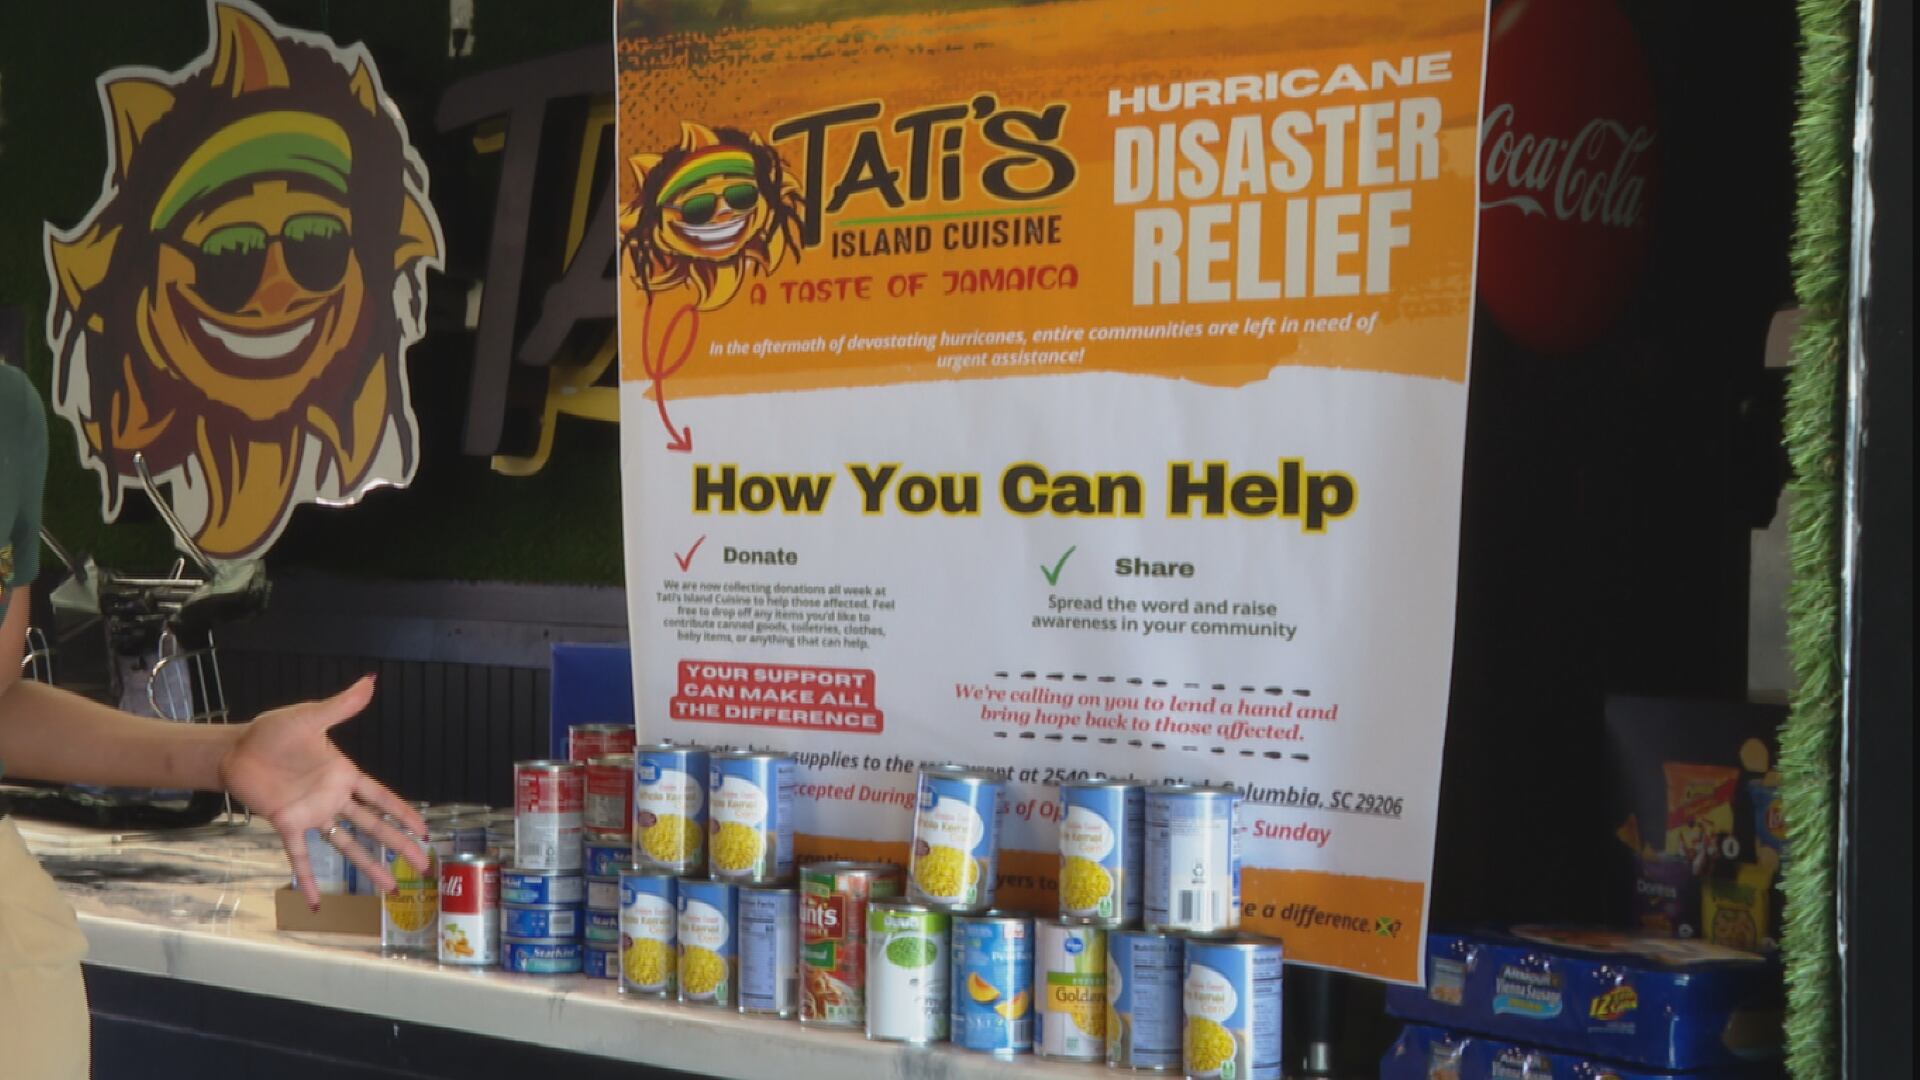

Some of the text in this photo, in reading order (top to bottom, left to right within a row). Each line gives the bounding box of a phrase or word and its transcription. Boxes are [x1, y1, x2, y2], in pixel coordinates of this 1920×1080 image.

[1108, 51, 1452, 117] HURRICANE
[1113, 97, 1442, 206] DISASTER
[831, 215, 1062, 259] ISLAND CUISINE
[1132, 188, 1412, 306] RELIEF
[750, 264, 1079, 305] A TASTE OF JAMAICA
[709, 311, 1379, 357] In the aftermath of devastating hurricanes, entire communities are left in need of
[937, 348, 1085, 373] urgent assistance!
[692, 456, 1360, 535] How You Can Help
[723, 546, 798, 566] Donate
[1114, 556, 1195, 578] Share
[663, 579, 886, 596] We are now collecting donations all week at
[683, 593, 713, 603] Island
[715, 594, 752, 605] Cuisine
[754, 596, 765, 606] to
[767, 594, 790, 608] help
[791, 596, 821, 607] those
[823, 597, 869, 609] affected.
[872, 599, 895, 610] Feel
[677, 606, 871, 623] free to drop off any items you'd like to
[1048, 594, 1277, 617] Spread the word and raise
[663, 618, 886, 637] contribute canned goods, toiletries, clothes,
[703, 630, 734, 643] items,
[735, 634, 747, 643] or
[749, 633, 795, 649] anything
[797, 635, 819, 648] that
[821, 638, 842, 648] can
[843, 636, 870, 652] help.
[1031, 616, 1297, 641] awareness in your community
[686, 663, 867, 688] YOUR SUPPORT
[683, 683, 869, 708] CAN MAKE ALL
[955, 683, 1338, 722] We're calling on you to lend a hand and
[676, 701, 878, 729] THE DIFFERENCE
[980, 704, 1304, 742] bring hope back to those affected.
[792, 750, 859, 773] supplies
[863, 754, 881, 771] to
[885, 754, 914, 774] the
[1019, 767, 1039, 782] at
[1043, 766, 1090, 783] 2540
[1236, 782, 1324, 809] olumbia,
[1330, 791, 1353, 809] SC
[1355, 793, 1404, 815] 29206
[859, 786, 916, 811] During
[1016, 799, 1036, 821] of
[1252, 819, 1331, 848] Sunday
[1040, 873, 1058, 890] to
[1262, 903, 1276, 918] a
[1280, 902, 1371, 933] difference.
